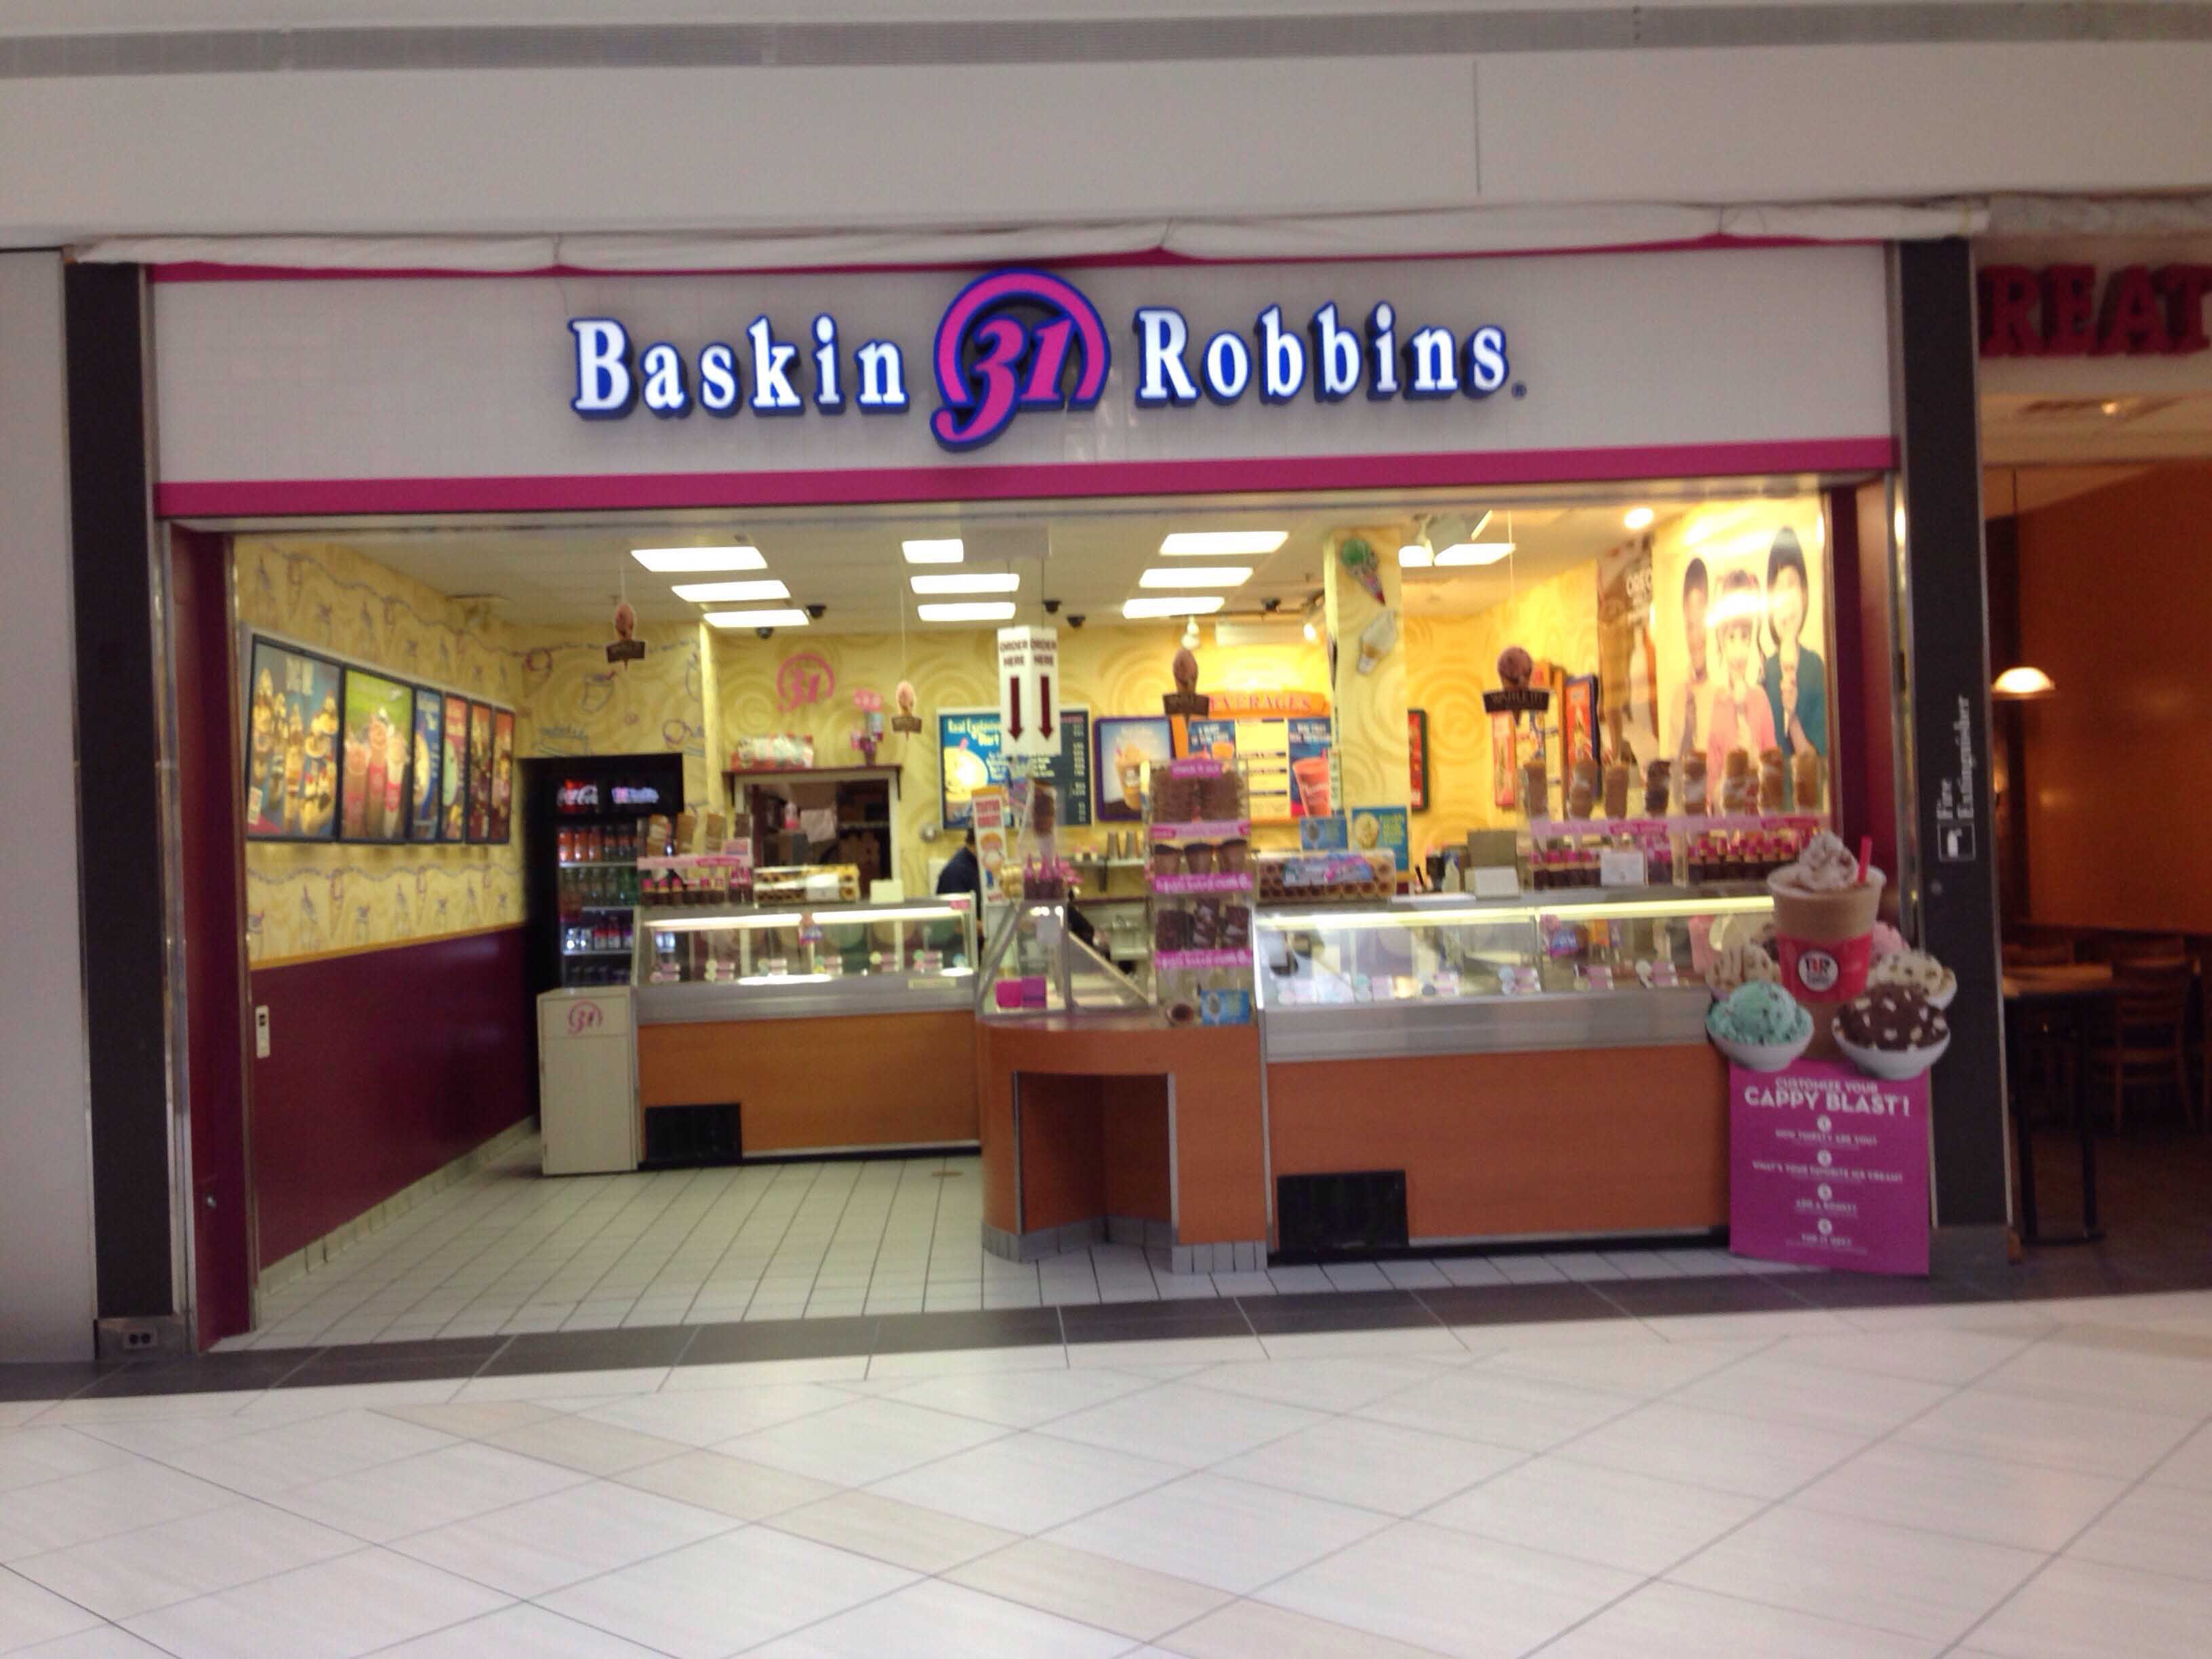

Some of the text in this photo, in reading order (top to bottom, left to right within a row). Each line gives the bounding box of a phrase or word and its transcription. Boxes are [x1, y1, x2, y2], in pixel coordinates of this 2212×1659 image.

[568, 313, 909, 416] Baskin
[1133, 300, 1510, 407] Robbins
[1744, 1086, 1910, 1117] CAPPY BLAST!
